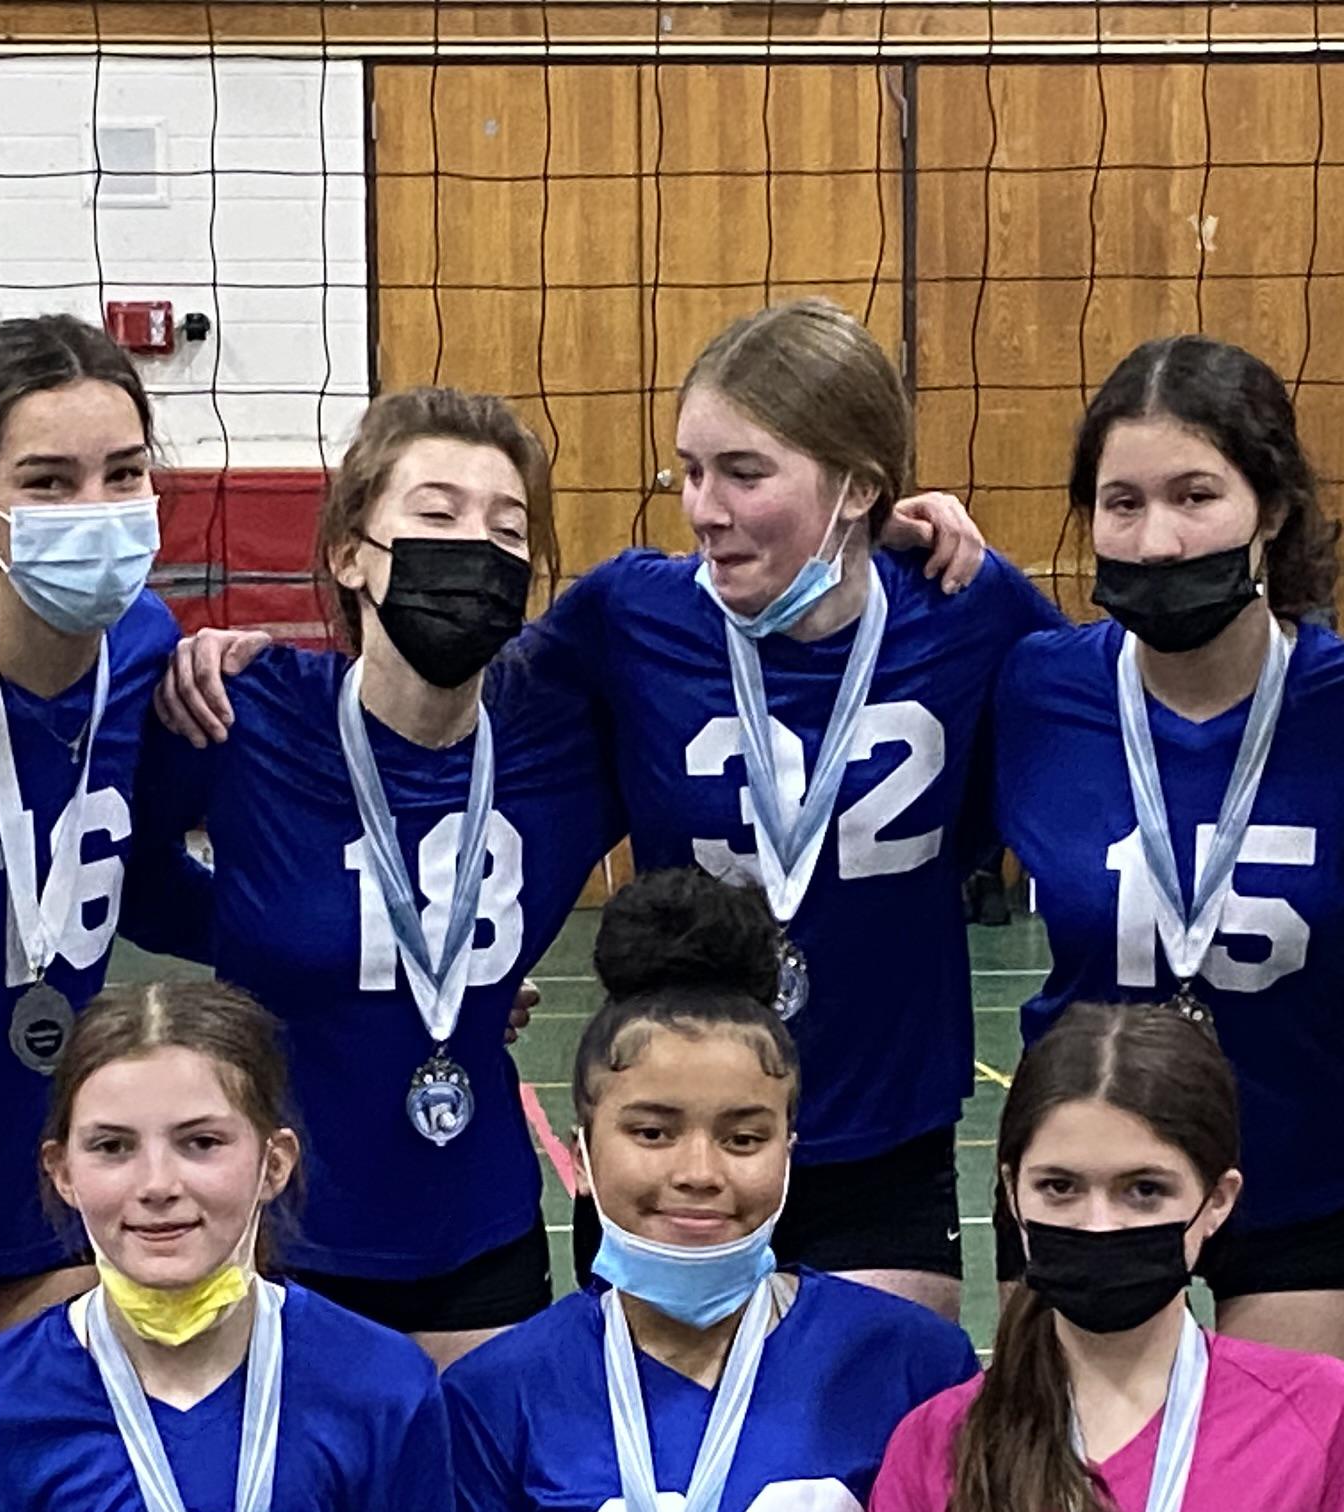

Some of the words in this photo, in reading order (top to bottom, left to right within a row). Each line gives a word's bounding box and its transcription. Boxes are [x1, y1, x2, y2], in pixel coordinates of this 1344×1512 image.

[685, 700, 946, 888] 32
[344, 809, 524, 991] 18
[1106, 823, 1317, 993] 15
